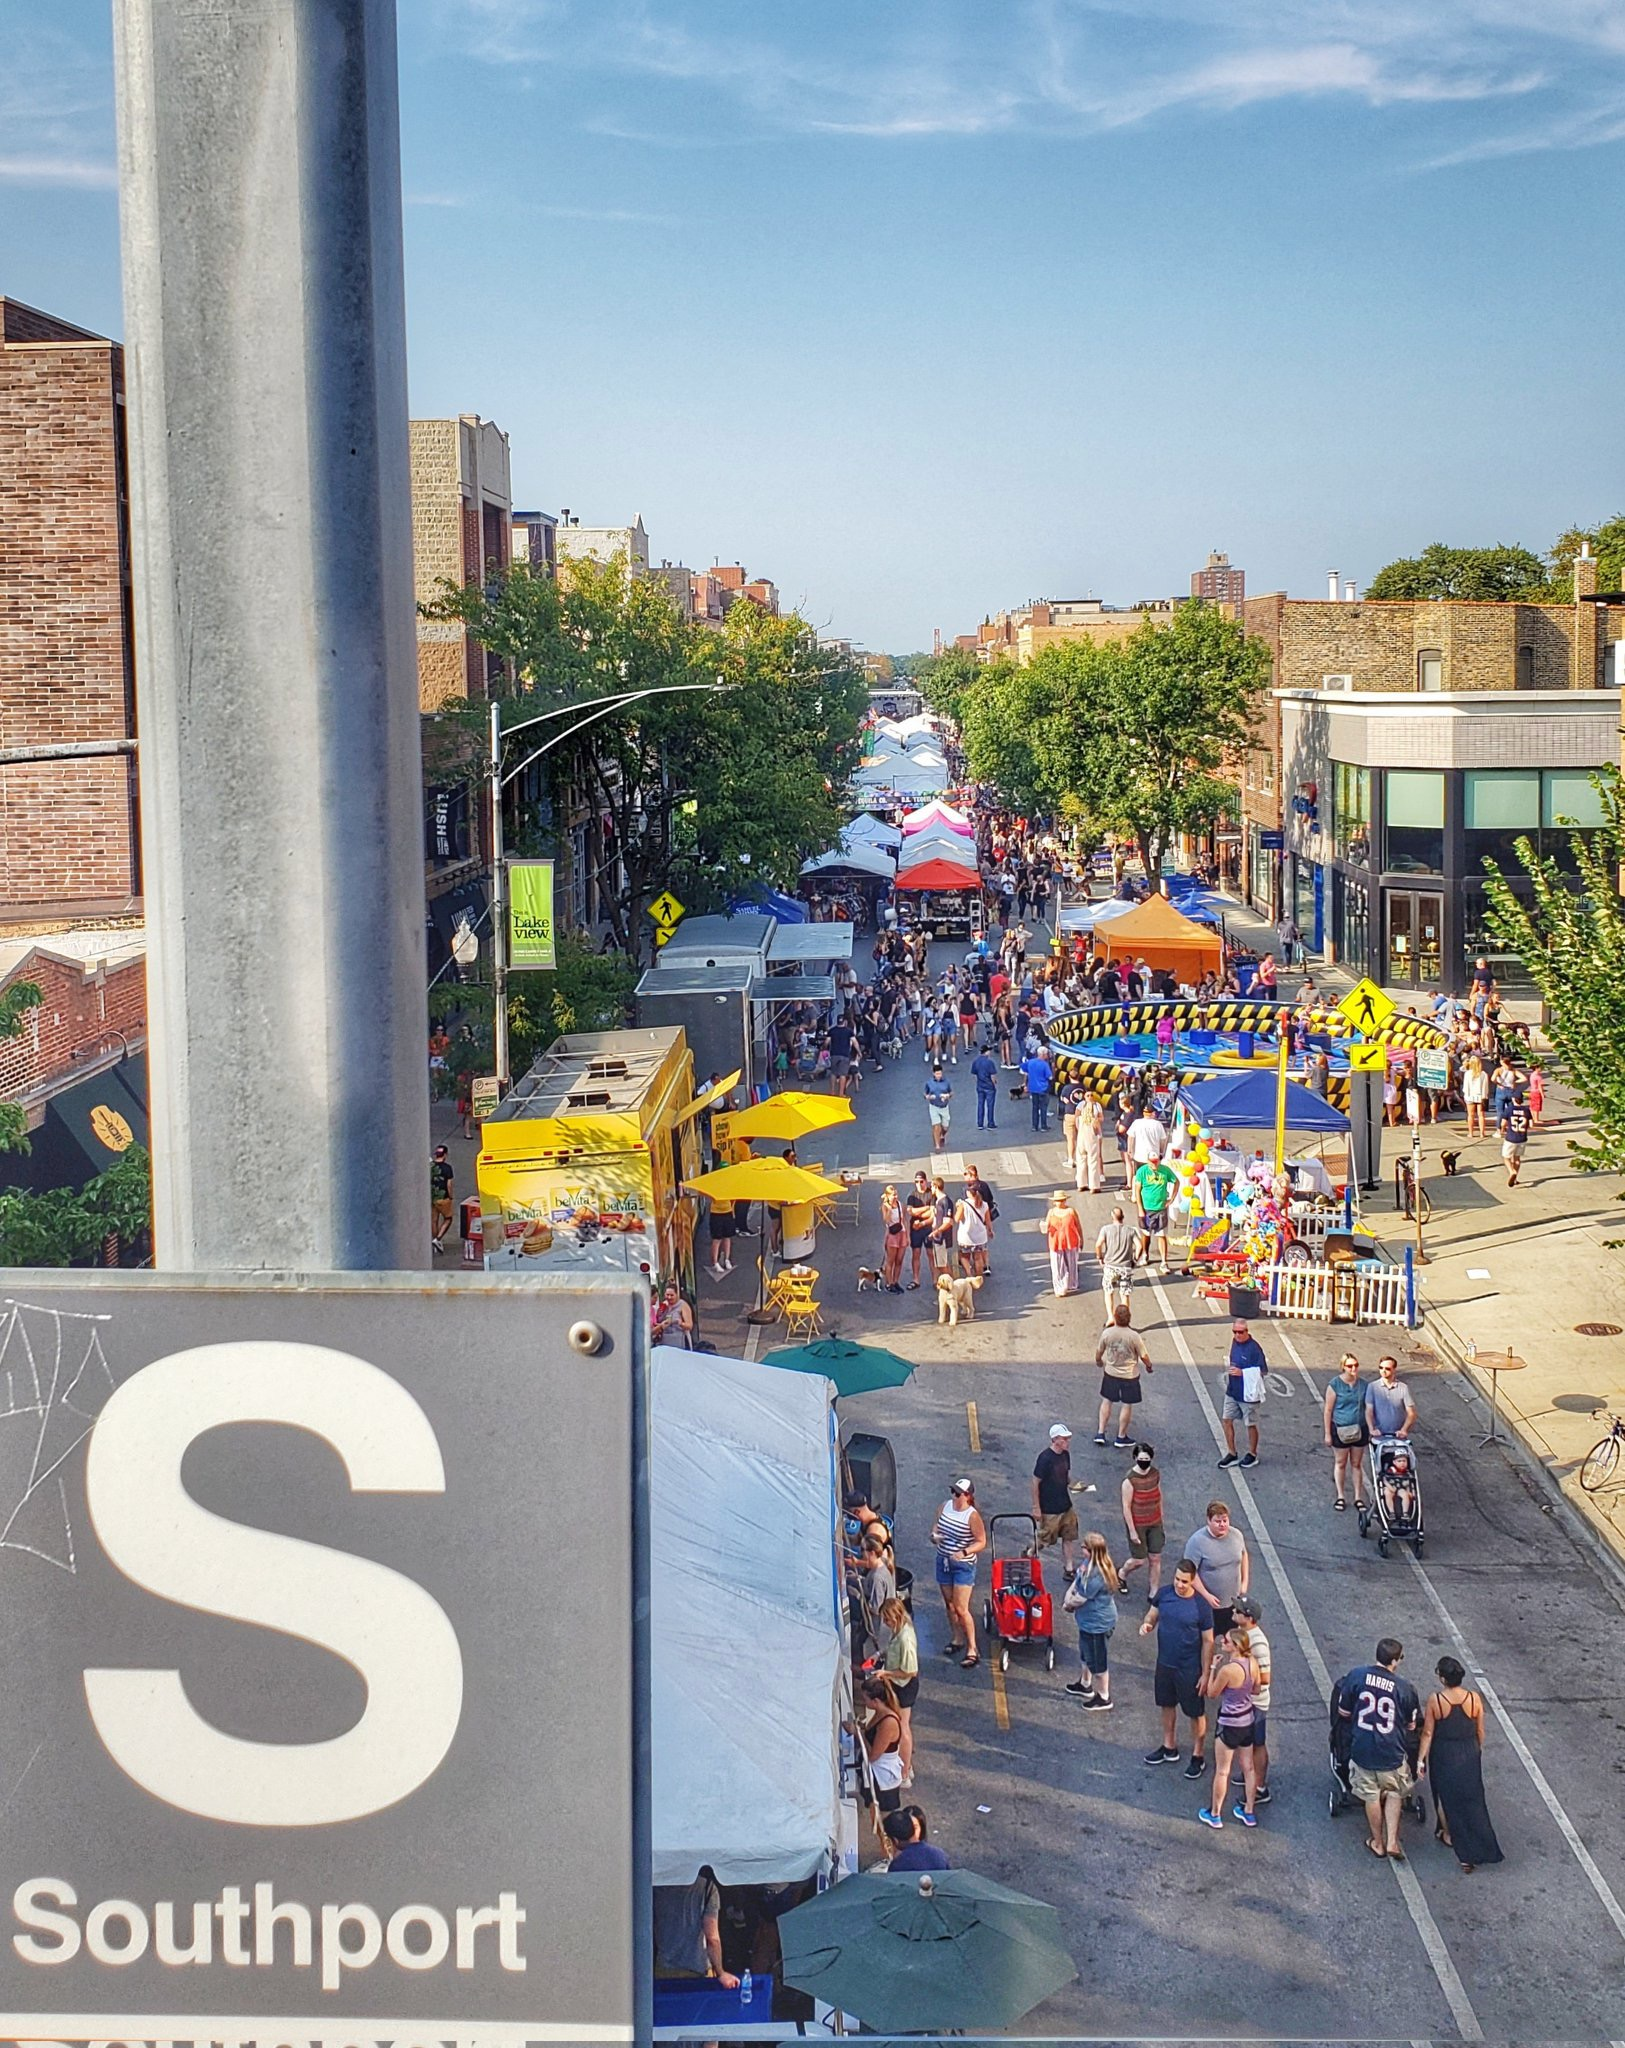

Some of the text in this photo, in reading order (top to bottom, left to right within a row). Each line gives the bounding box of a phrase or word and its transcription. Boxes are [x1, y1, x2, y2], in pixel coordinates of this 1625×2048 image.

[514, 916, 549, 928] Lake
[514, 928, 549, 939] view
[1510, 1116, 1527, 1132] 52
[555, 1194, 590, 1208] belVita
[602, 1196, 638, 1212] belVita
[83, 1340, 464, 1826] S
[1365, 1673, 1395, 1692] HARRIS
[1357, 1691, 1396, 1734] 29
[12, 1876, 527, 1991] Southport
